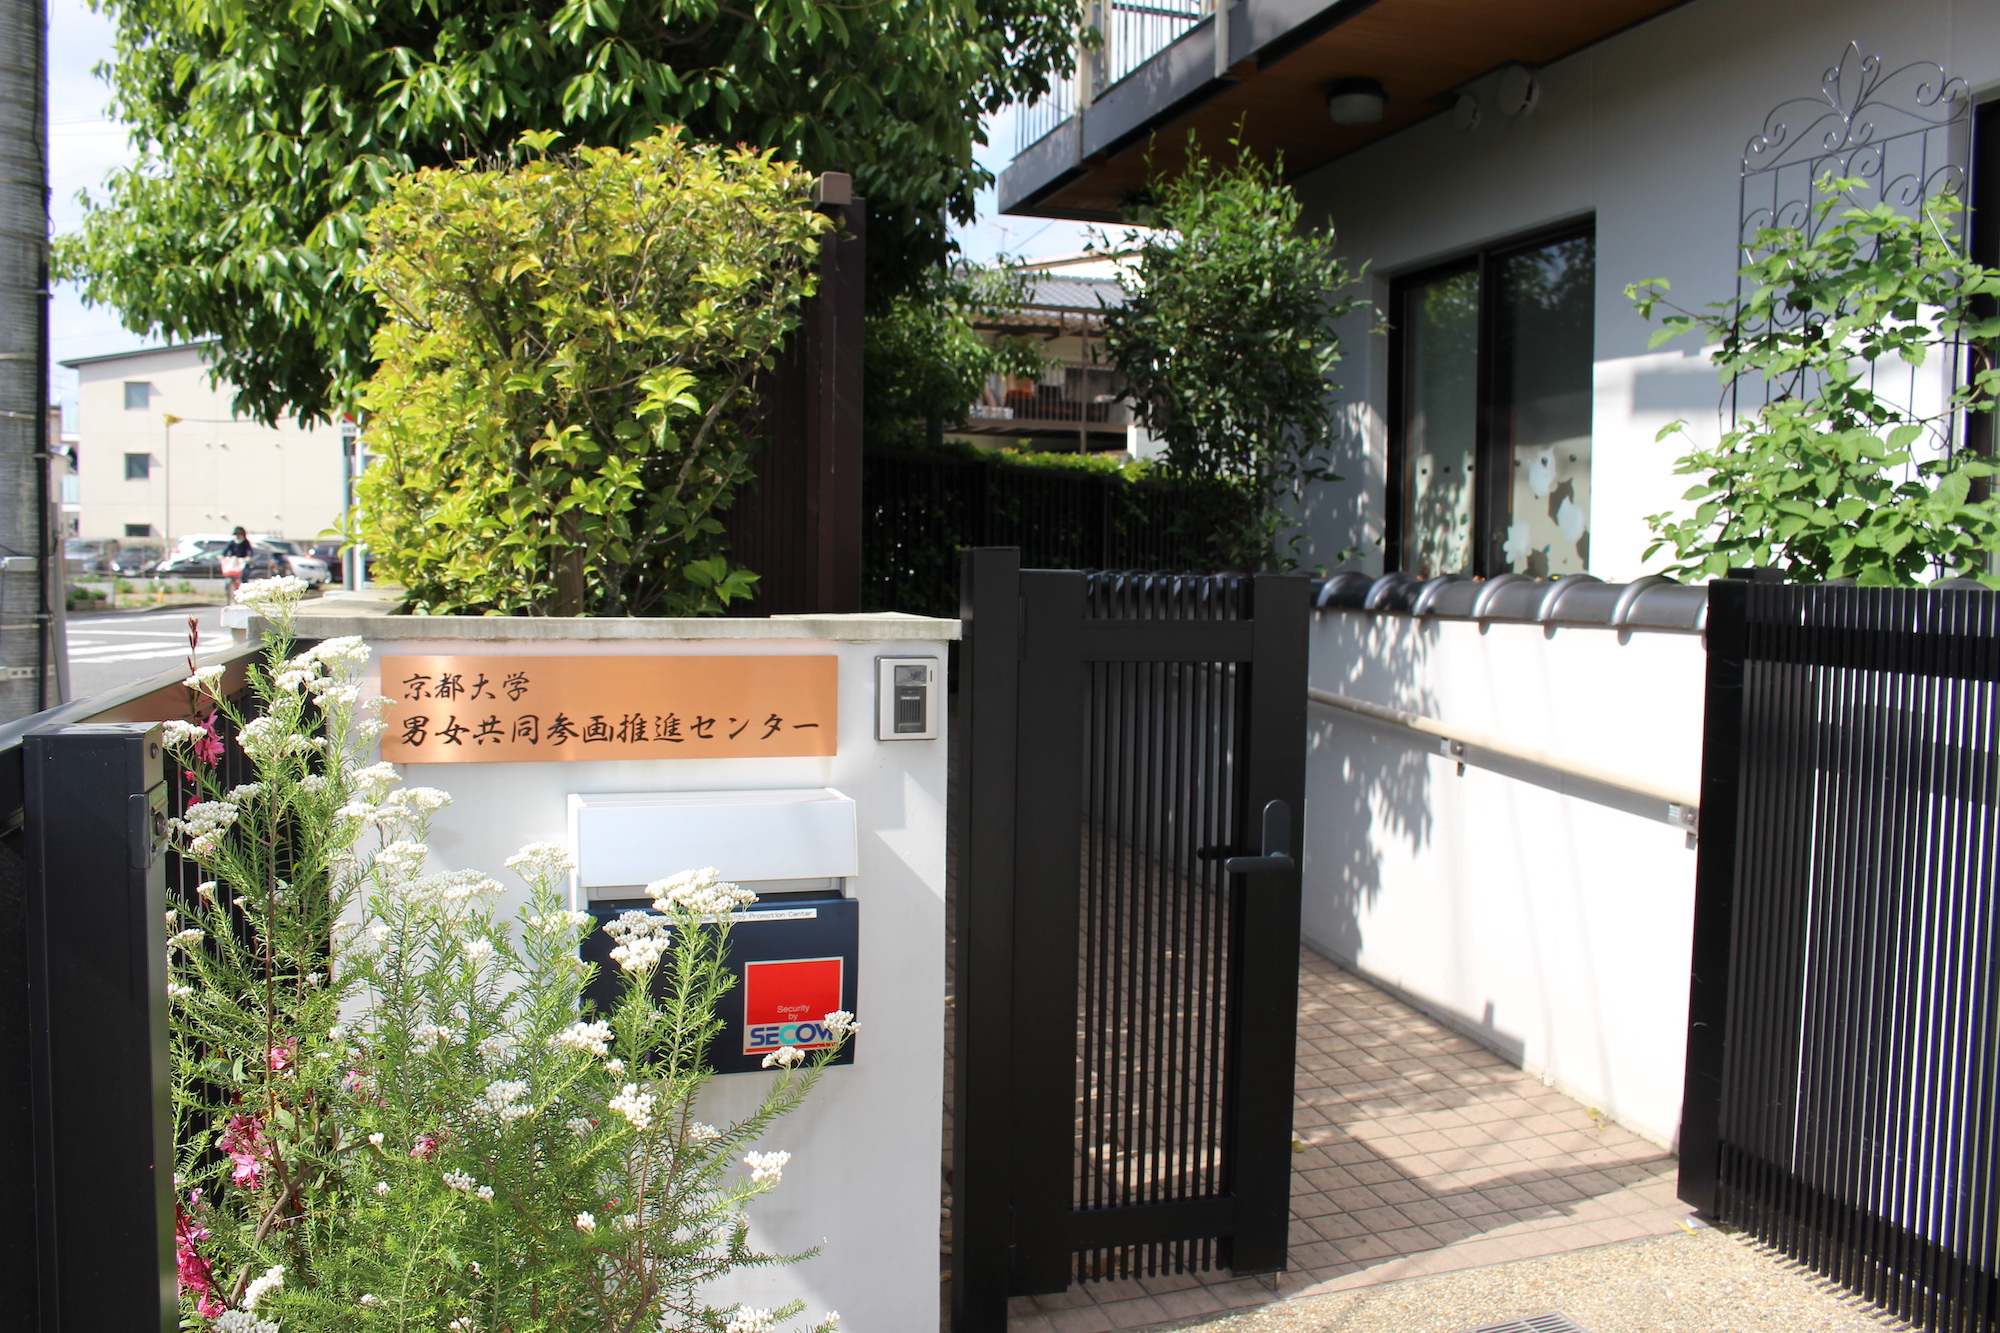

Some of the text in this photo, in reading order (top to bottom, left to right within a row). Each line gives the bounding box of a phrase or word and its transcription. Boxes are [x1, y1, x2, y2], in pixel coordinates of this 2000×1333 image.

[402, 671, 531, 702] 京都大学
[401, 712, 819, 747] 男女共同参画推進センター
[749, 911, 786, 919] Promotion
[776, 1004, 811, 1014] Security
[788, 1013, 799, 1022] by
